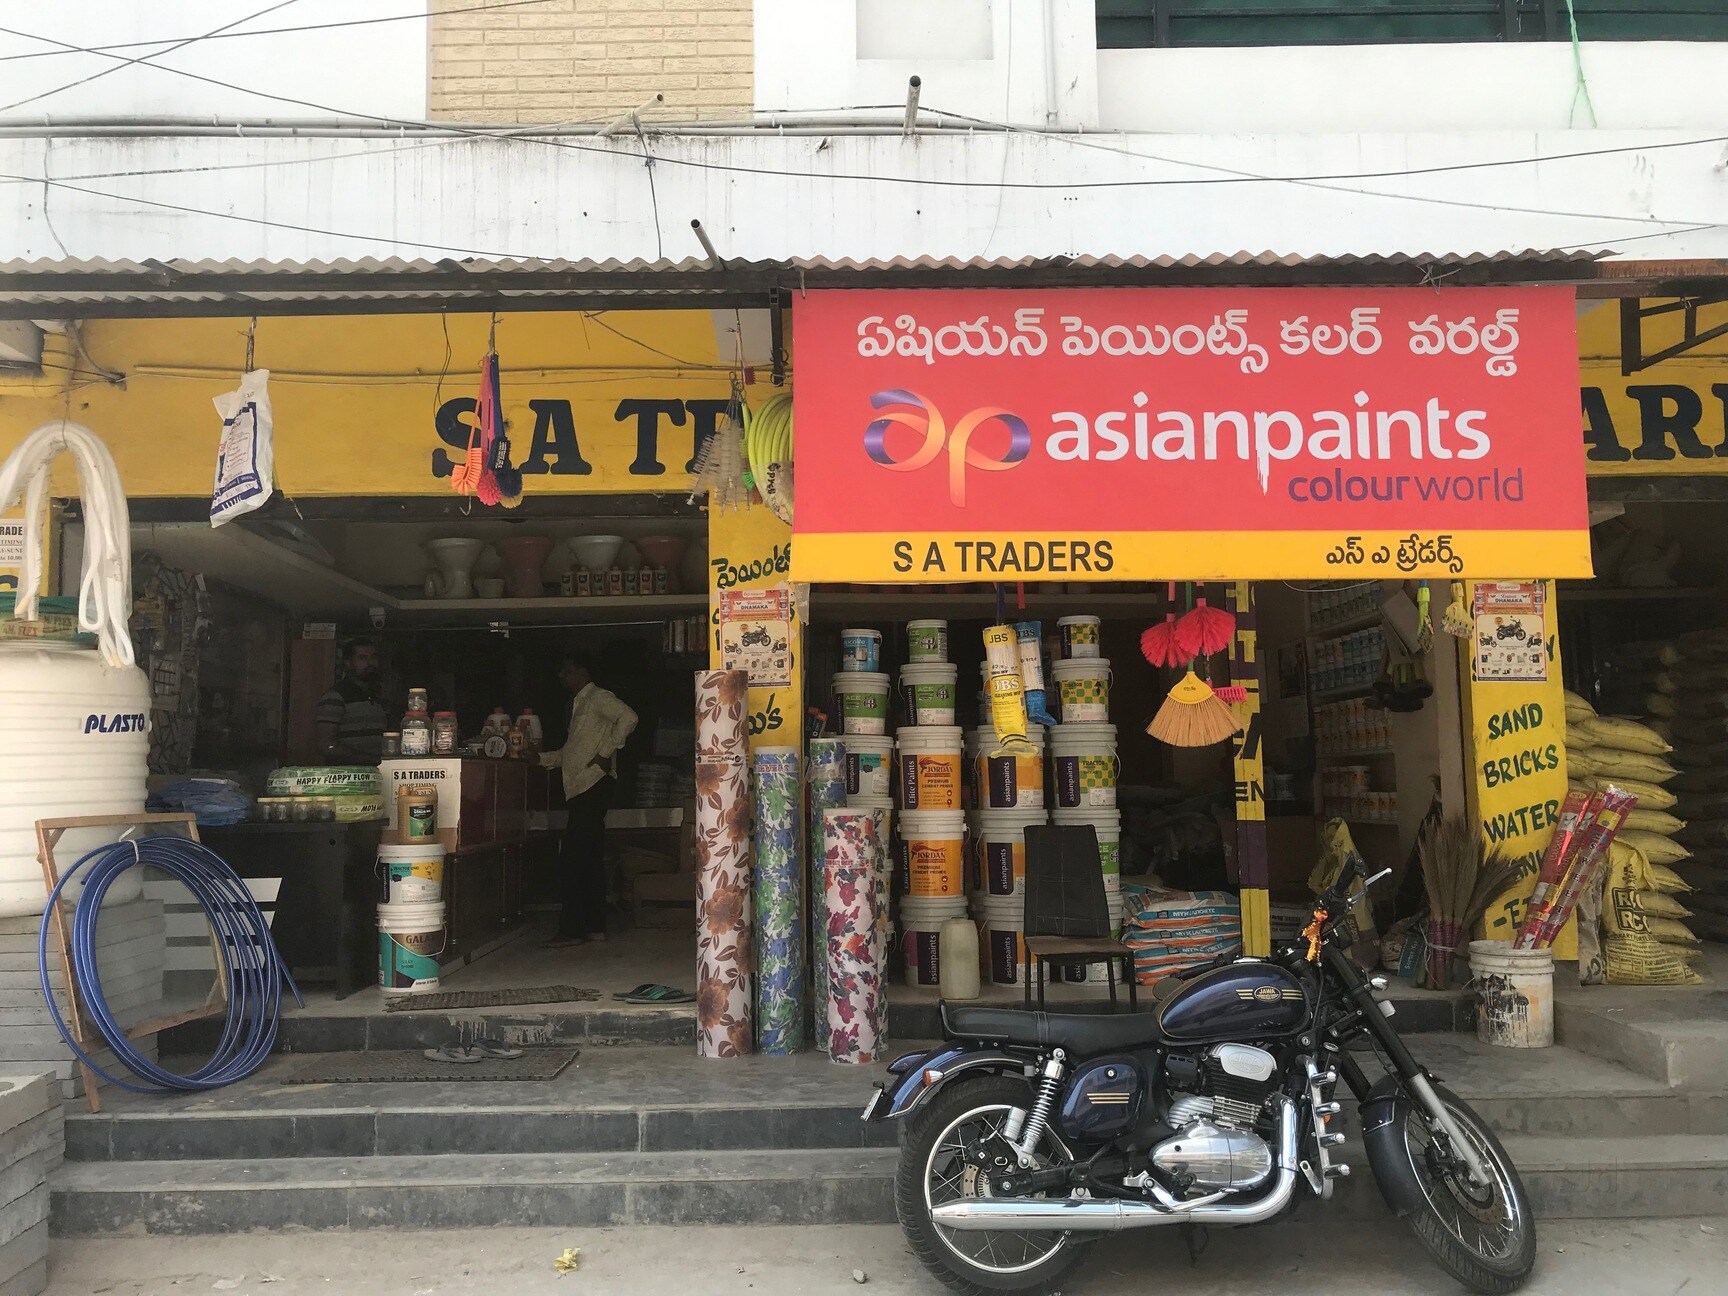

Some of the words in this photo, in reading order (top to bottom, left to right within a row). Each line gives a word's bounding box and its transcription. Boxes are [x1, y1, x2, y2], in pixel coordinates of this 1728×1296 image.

[857, 308, 1048, 365] ఏషియన్
[1059, 309, 1269, 374] పెయింట్స్
[1279, 307, 1383, 356] కలర్
[1408, 308, 1520, 377] వరల్డ్
[519, 399, 593, 475] A
[1046, 390, 1491, 495] asianpaints
[892, 540, 913, 572] S
[922, 541, 946, 572] A
[954, 540, 1115, 572] TRADERS
[1325, 536, 1365, 565] ఎస్
[989, 633, 1009, 645] JBS
[994, 677, 1020, 692] JBS
[84, 713, 145, 734] PLASTO
[1487, 702, 1544, 741] SAND
[394, 771, 399, 780] S
[401, 771, 407, 780] A
[409, 770, 446, 780] TRADERS
[908, 761, 916, 785] Paints
[1483, 744, 1559, 788] BRICKS
[296, 777, 321, 786] HAPPY
[908, 786, 917, 804] Elite
[1484, 799, 1560, 843] WATER
[917, 851, 945, 859] JORDAN
